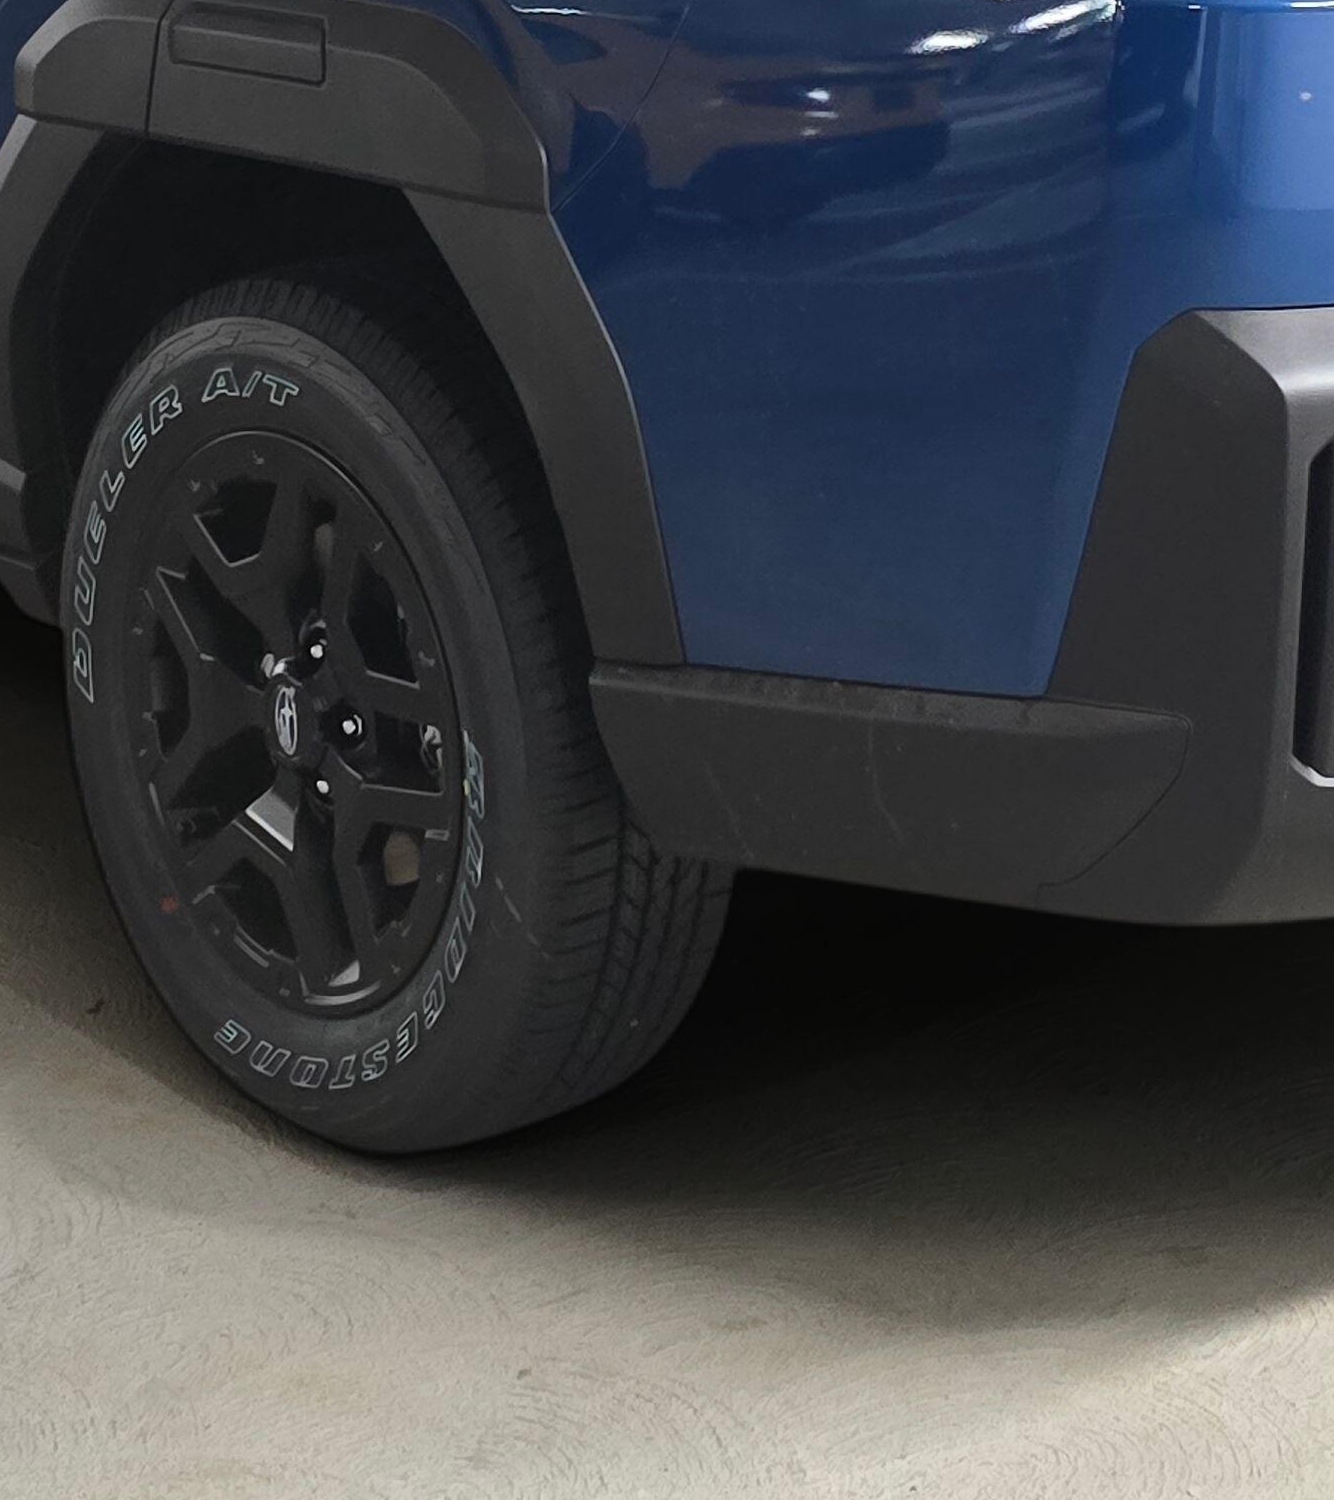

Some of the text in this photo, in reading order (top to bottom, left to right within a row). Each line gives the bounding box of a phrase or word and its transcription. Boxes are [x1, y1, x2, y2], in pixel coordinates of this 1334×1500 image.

[71, 366, 300, 703] DUELER A/T
[212, 725, 486, 1092] BRIDGESTONE
